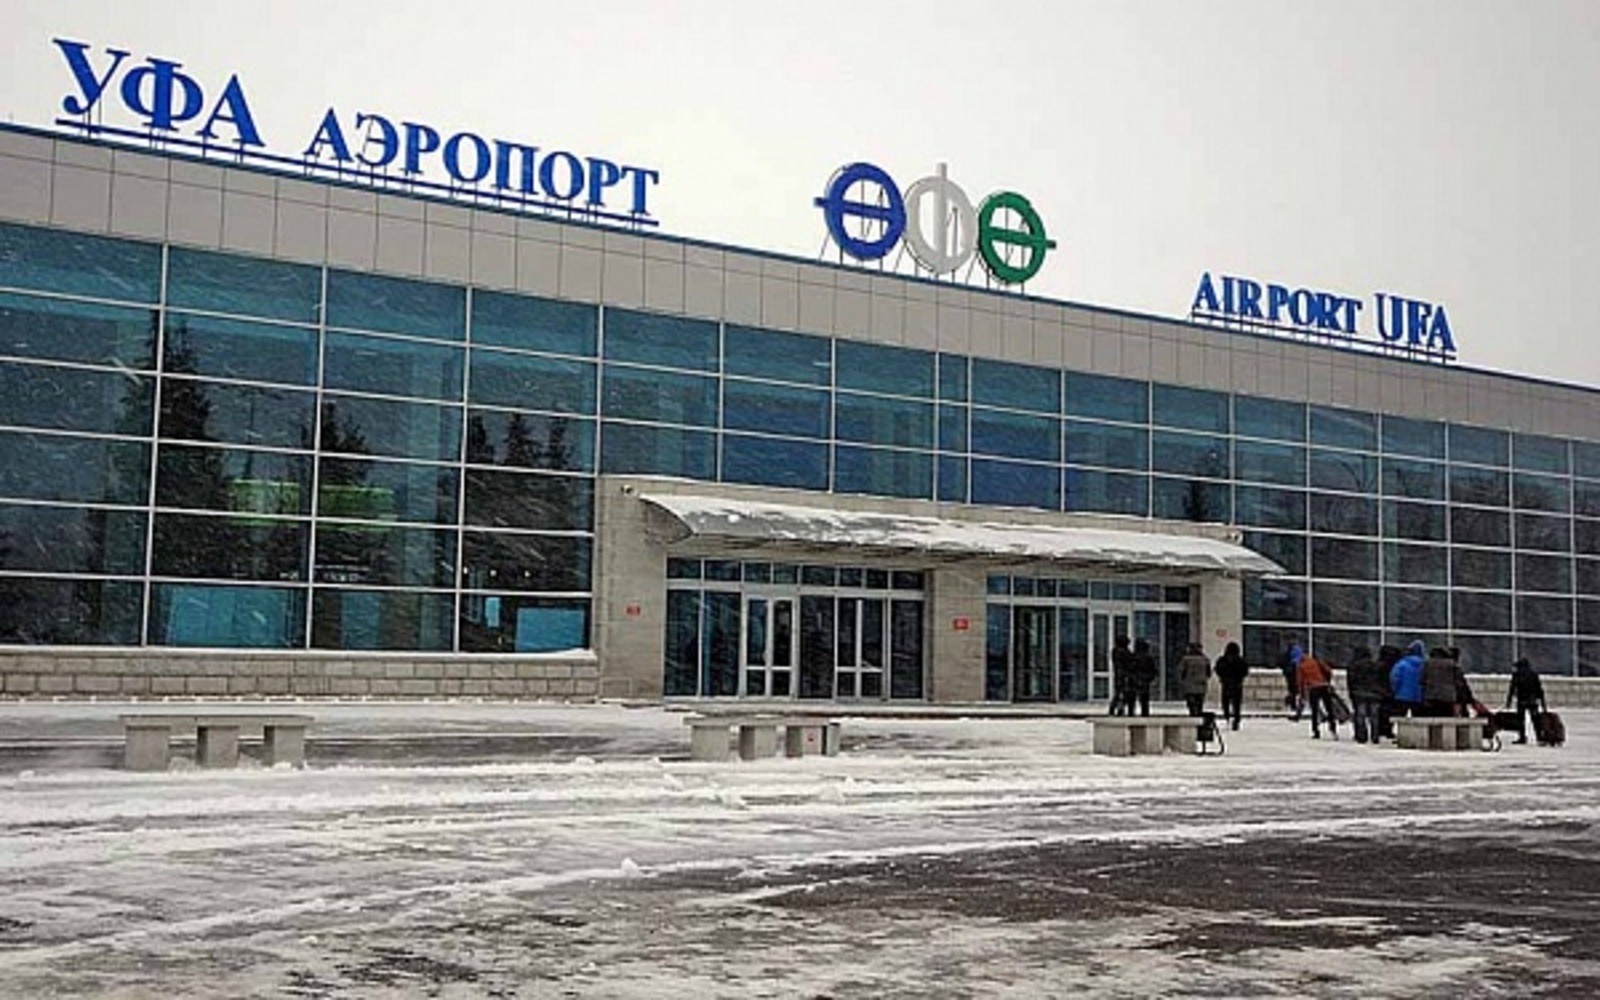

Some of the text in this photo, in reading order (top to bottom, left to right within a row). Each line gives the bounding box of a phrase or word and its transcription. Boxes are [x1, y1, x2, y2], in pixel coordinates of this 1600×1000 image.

[53, 38, 660, 217] УФА АЭРОПОРТ
[1192, 271, 1456, 352] AIRPORT UFA
